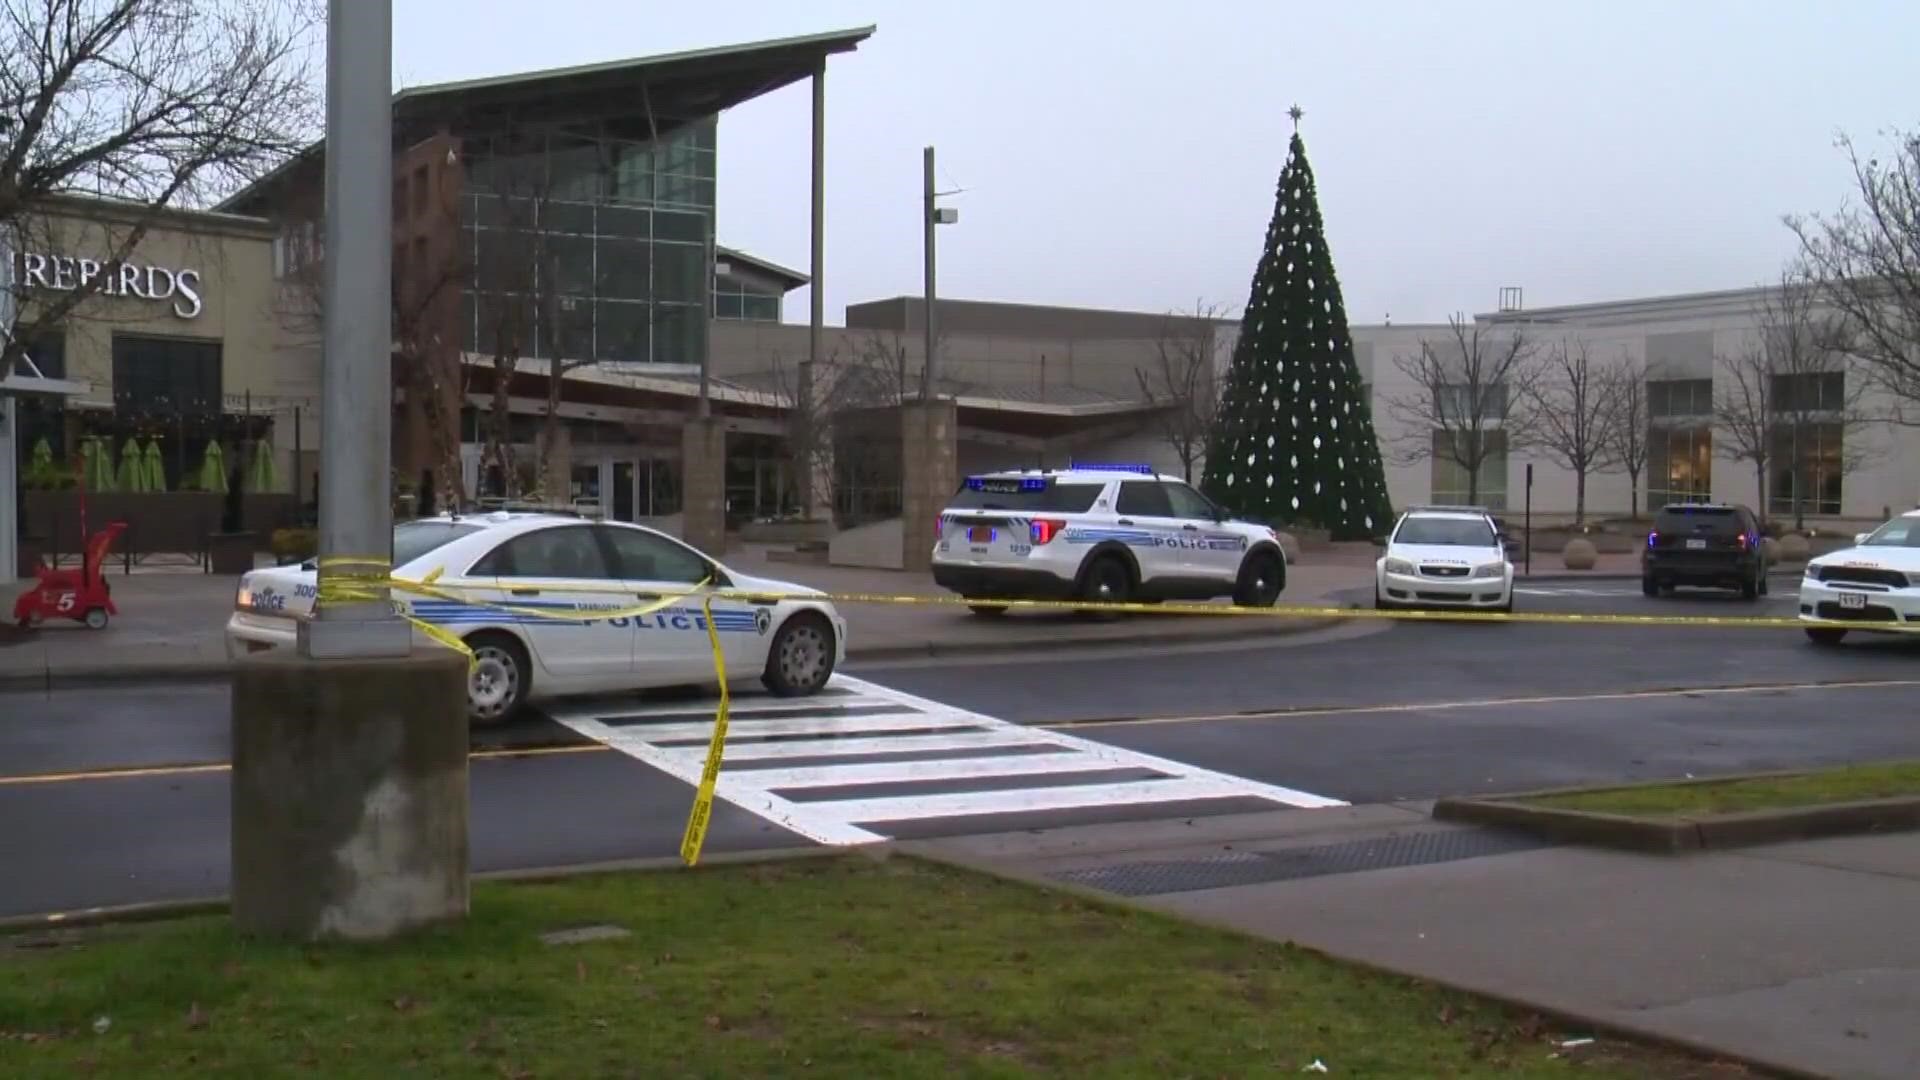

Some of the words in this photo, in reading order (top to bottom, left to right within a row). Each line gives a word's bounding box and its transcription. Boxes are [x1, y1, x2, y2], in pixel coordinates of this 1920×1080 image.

[1154, 537, 1217, 550] POLICE
[57, 592, 76, 612] 5
[251, 592, 286, 609] POLICE
